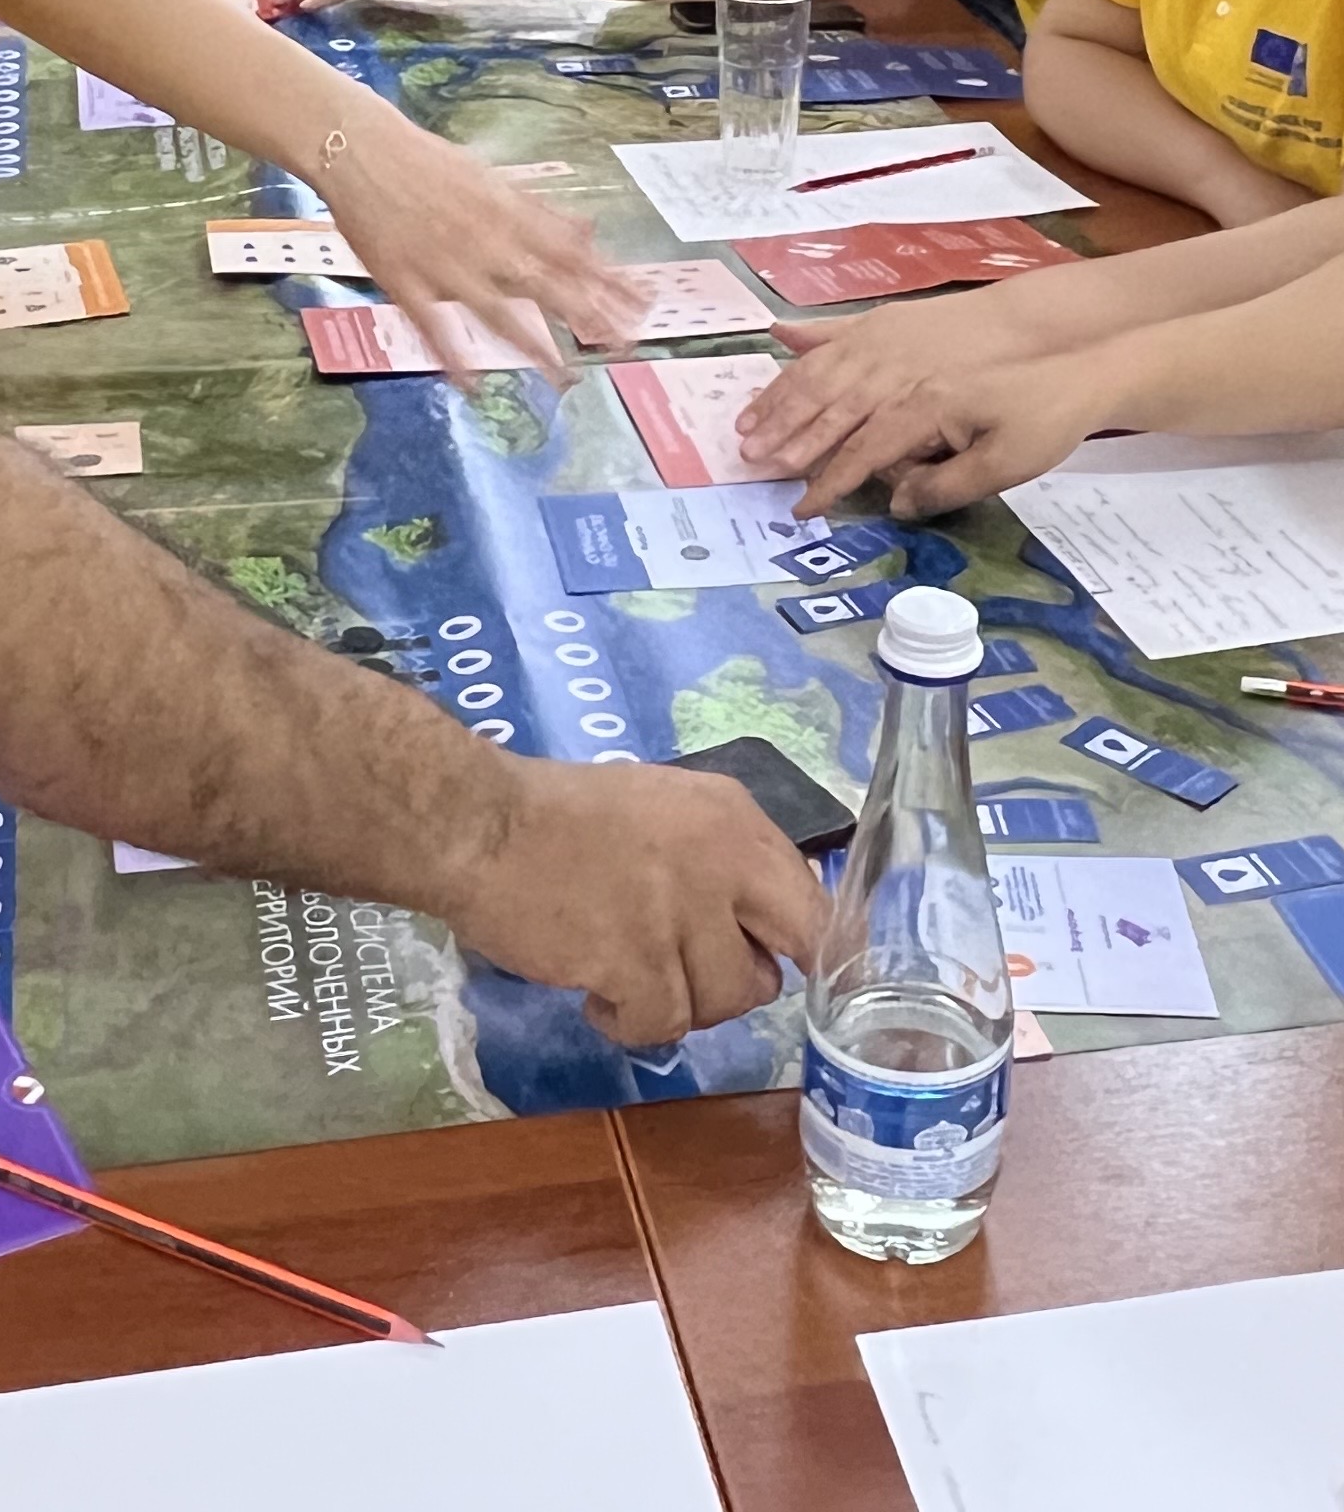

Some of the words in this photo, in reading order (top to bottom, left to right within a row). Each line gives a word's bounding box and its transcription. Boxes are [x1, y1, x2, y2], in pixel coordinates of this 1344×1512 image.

[252, 879, 311, 1021] ЕРРИТОРИЙ
[300, 888, 362, 1076] БОЛОЧЕННЫХ
[348, 902, 403, 1035] СИСТЕМА
